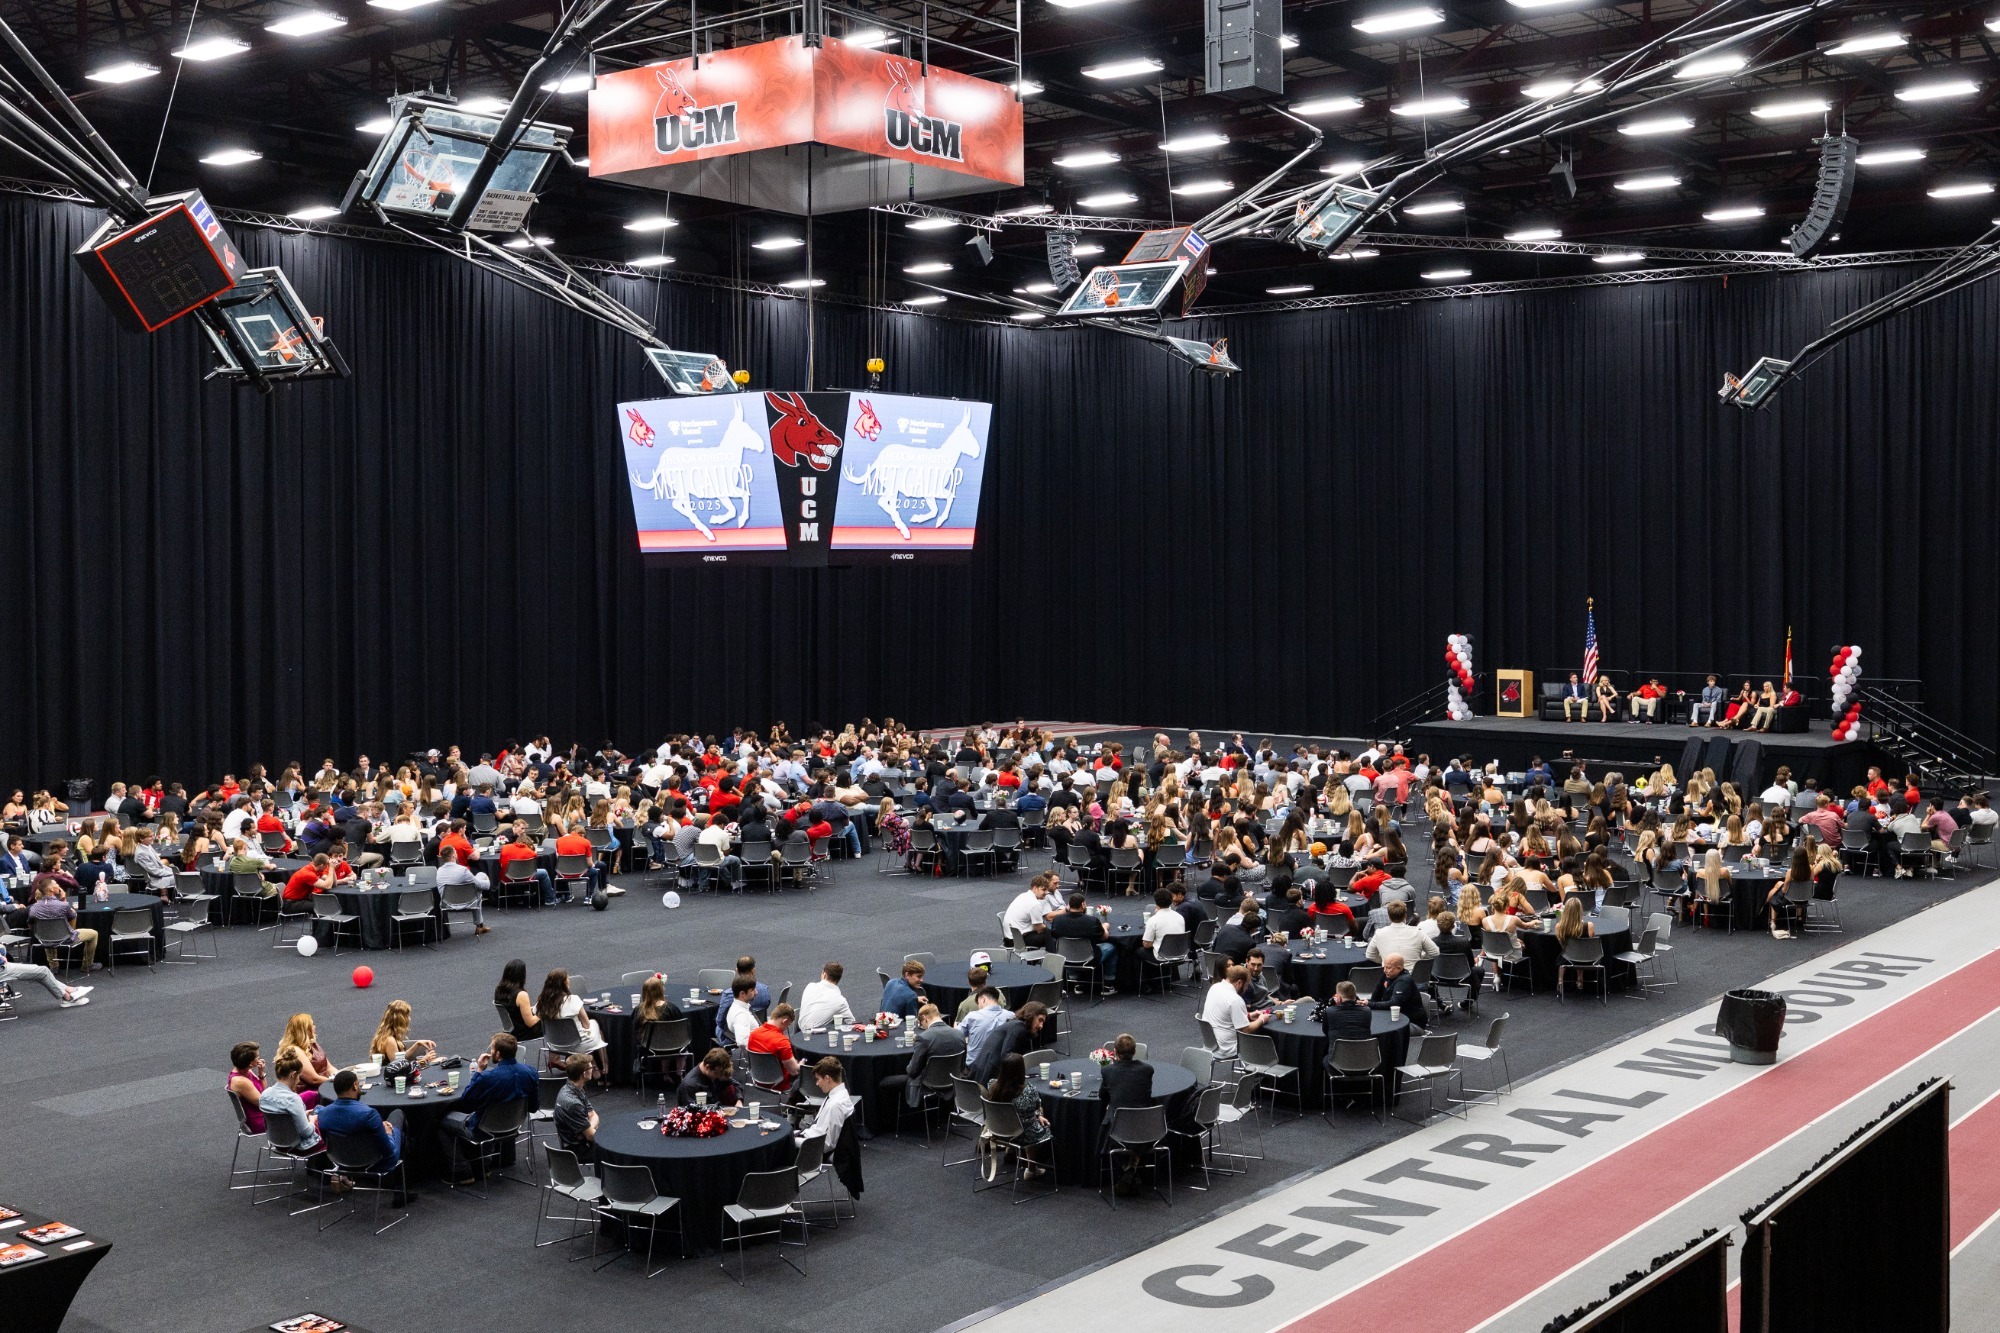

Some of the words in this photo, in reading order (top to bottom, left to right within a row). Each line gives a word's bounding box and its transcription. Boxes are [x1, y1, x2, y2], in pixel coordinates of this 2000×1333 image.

[653, 101, 739, 154] UCM
[884, 108, 964, 163] UCM
[485, 192, 516, 201] BASKETBALL
[652, 467, 688, 500] MET
[691, 463, 754, 498] GALLOP
[861, 463, 900, 496] MET
[904, 465, 964, 499] GALLOP
[690, 500, 721, 511] 2025
[895, 499, 927, 509] 2025
[1141, 1088, 1669, 1309] CENTRAL
[1613, 951, 1935, 1080] MIOURI
